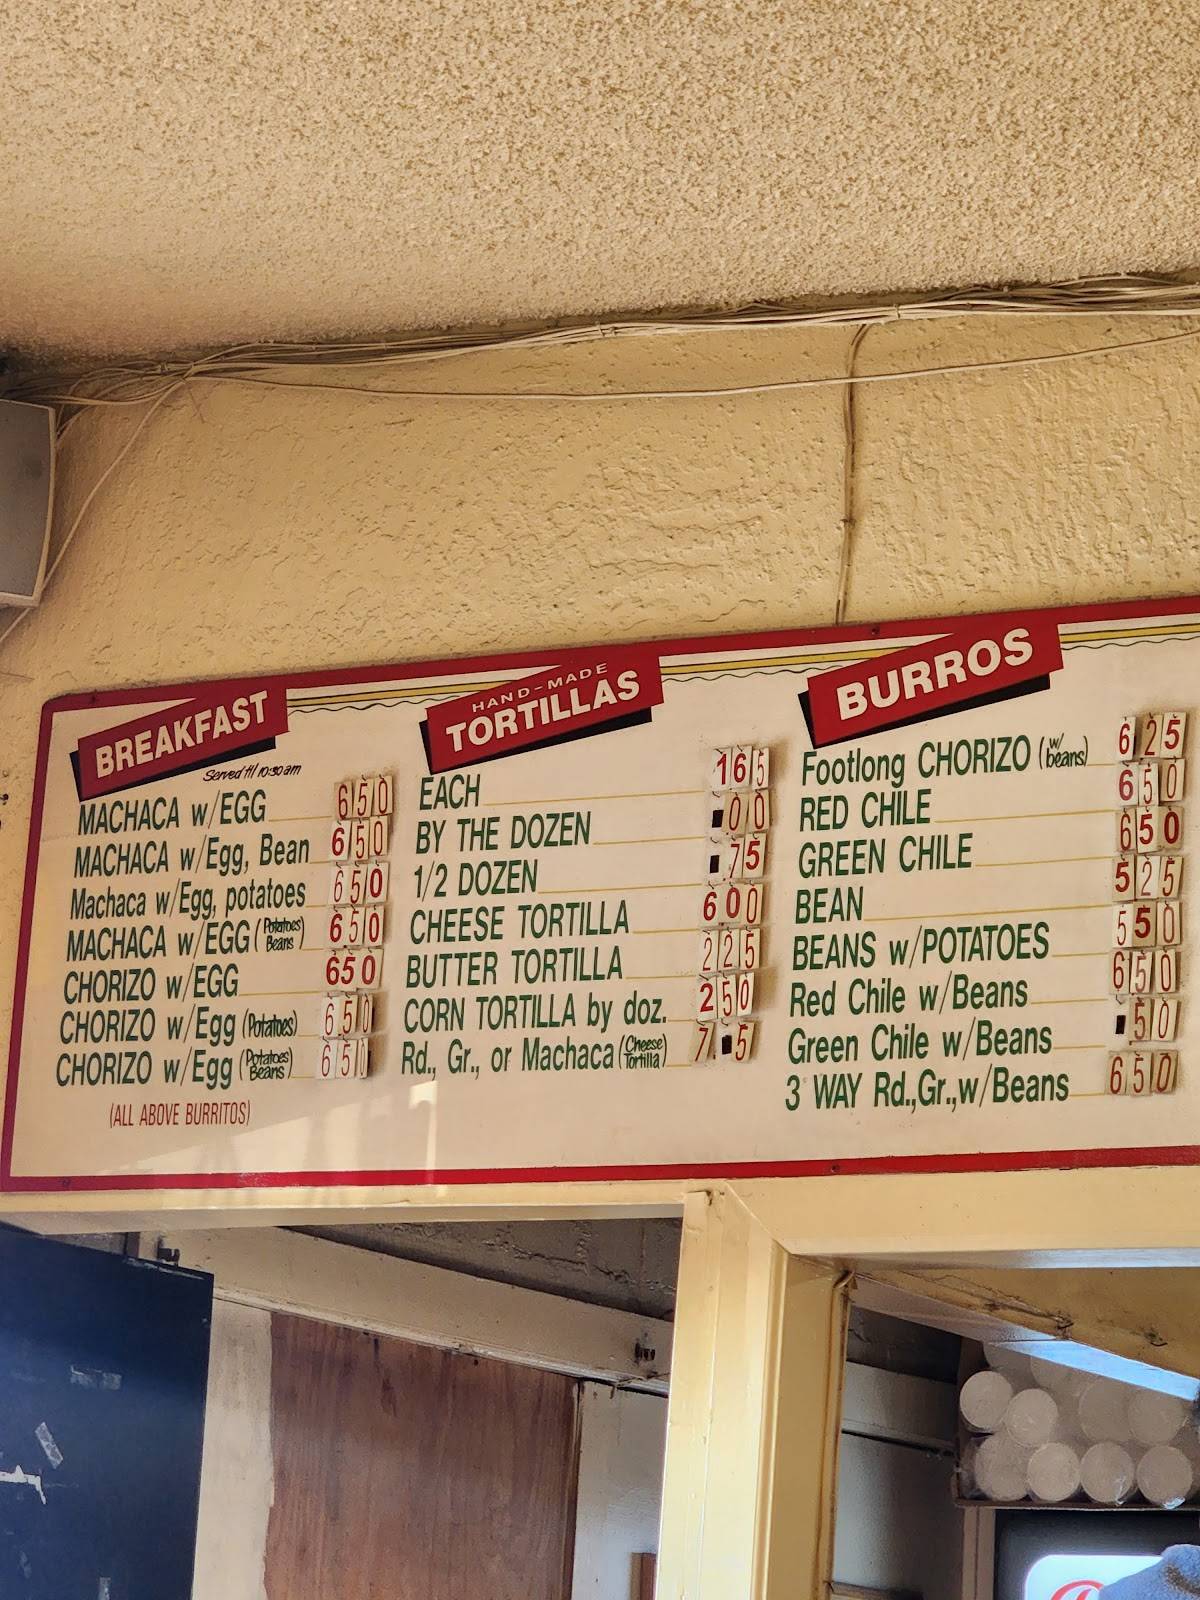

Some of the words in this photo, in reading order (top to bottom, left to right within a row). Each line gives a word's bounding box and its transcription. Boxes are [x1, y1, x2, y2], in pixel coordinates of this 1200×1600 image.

[472, 663, 608, 713] HAND-MADE
[836, 628, 1034, 720] BURROS
[95, 690, 268, 779] BREAKFAST
[445, 670, 640, 752] TORTILLAS
[203, 764, 247, 781] Served
[419, 773, 481, 811] EACH
[715, 750, 765, 788] 165
[802, 748, 906, 789] Footlong
[918, 734, 1031, 778] CHORIZO
[1119, 718, 1180, 756] 625
[78, 797, 180, 835] MACHACA
[192, 788, 267, 830] w/EGG
[338, 775, 389, 820] 650
[800, 795, 849, 832] RED
[861, 788, 931, 827] CHILE
[1119, 763, 1177, 804] 650
[74, 842, 169, 878] MACHACA
[260, 833, 310, 865] Bean
[331, 823, 384, 861] 650
[416, 819, 447, 855] BY
[457, 816, 500, 852] THE
[510, 811, 592, 849] DOZEN
[799, 839, 886, 879] GREEN
[899, 832, 973, 872] CHILE
[1120, 811, 1180, 850] 650
[70, 888, 146, 920] Machaca
[225, 880, 306, 917] potatoes
[333, 868, 384, 904] 650
[413, 861, 449, 902] 1/2
[458, 859, 539, 897] DOZEN
[795, 887, 864, 924] BEAN
[1115, 859, 1175, 897] 525
[66, 926, 167, 962] MACHACA
[178, 919, 250, 959] w/EGG
[329, 907, 380, 944] 650
[410, 905, 504, 945] CHEESE
[517, 900, 630, 939] TORTILLA
[703, 887, 758, 924] 600
[792, 931, 876, 971] BEANS
[889, 921, 1050, 968] w/POTATOES
[1117, 905, 1175, 946] 550
[64, 968, 155, 1004] CHORIZO
[166, 963, 239, 1002] w/EGG
[326, 954, 376, 986] 650
[406, 950, 498, 989] BUTTER
[511, 946, 623, 985] TORTILLA
[702, 933, 755, 971] 225
[790, 981, 835, 1017] Red
[849, 977, 906, 1015] Chile
[919, 970, 1028, 1014] w/Beans
[1113, 950, 1172, 993] 650
[60, 1008, 155, 1045] CHORIZO
[168, 1004, 236, 1046] w/Egg
[243, 1008, 298, 1039] (Potatoes)
[325, 999, 370, 1035] 650
[404, 997, 465, 1034] CORN
[476, 993, 576, 1031] TORTILLA
[587, 992, 613, 1033] by
[623, 990, 667, 1025] doz.
[700, 979, 749, 1017] 250
[491, 1046, 512, 1072] or
[521, 1036, 614, 1072] Machaca
[788, 1027, 858, 1064] Green
[871, 1023, 929, 1060] Chile
[942, 1016, 1053, 1061] w/Beans
[56, 1050, 152, 1087] CHORIZO
[164, 1048, 232, 1090] w/Egg
[785, 1074, 801, 1111] 3
[814, 1072, 862, 1109] WAY
[1109, 1055, 1170, 1095] 650
[110, 1103, 134, 1128] (ALL
[140, 1103, 179, 1126] ABOVE
[186, 1100, 251, 1127] BURRITOS)
